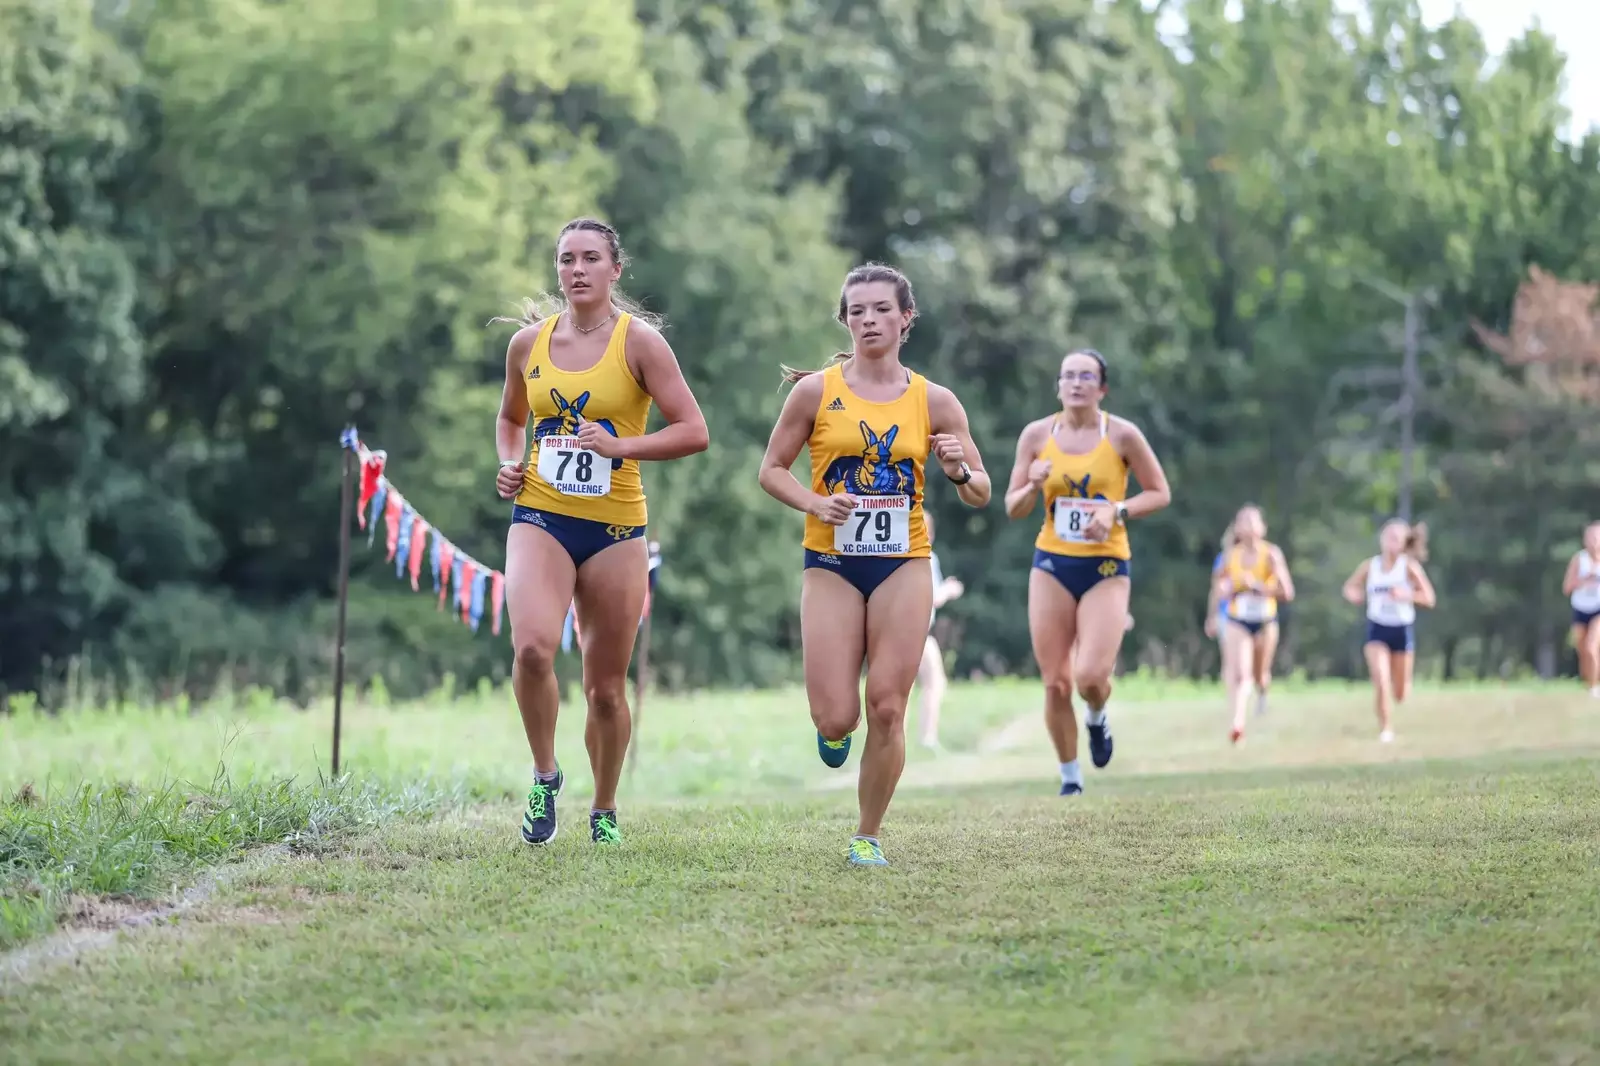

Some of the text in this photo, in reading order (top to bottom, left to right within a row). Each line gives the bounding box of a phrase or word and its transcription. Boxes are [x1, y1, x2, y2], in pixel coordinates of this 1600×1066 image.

[546, 438, 562, 448] BOB
[556, 451, 593, 482] 78
[557, 483, 603, 494] CHALLENGE
[861, 497, 905, 509] TIMMONS
[855, 511, 891, 542] 79
[843, 543, 902, 553] XC CHALLENGE
